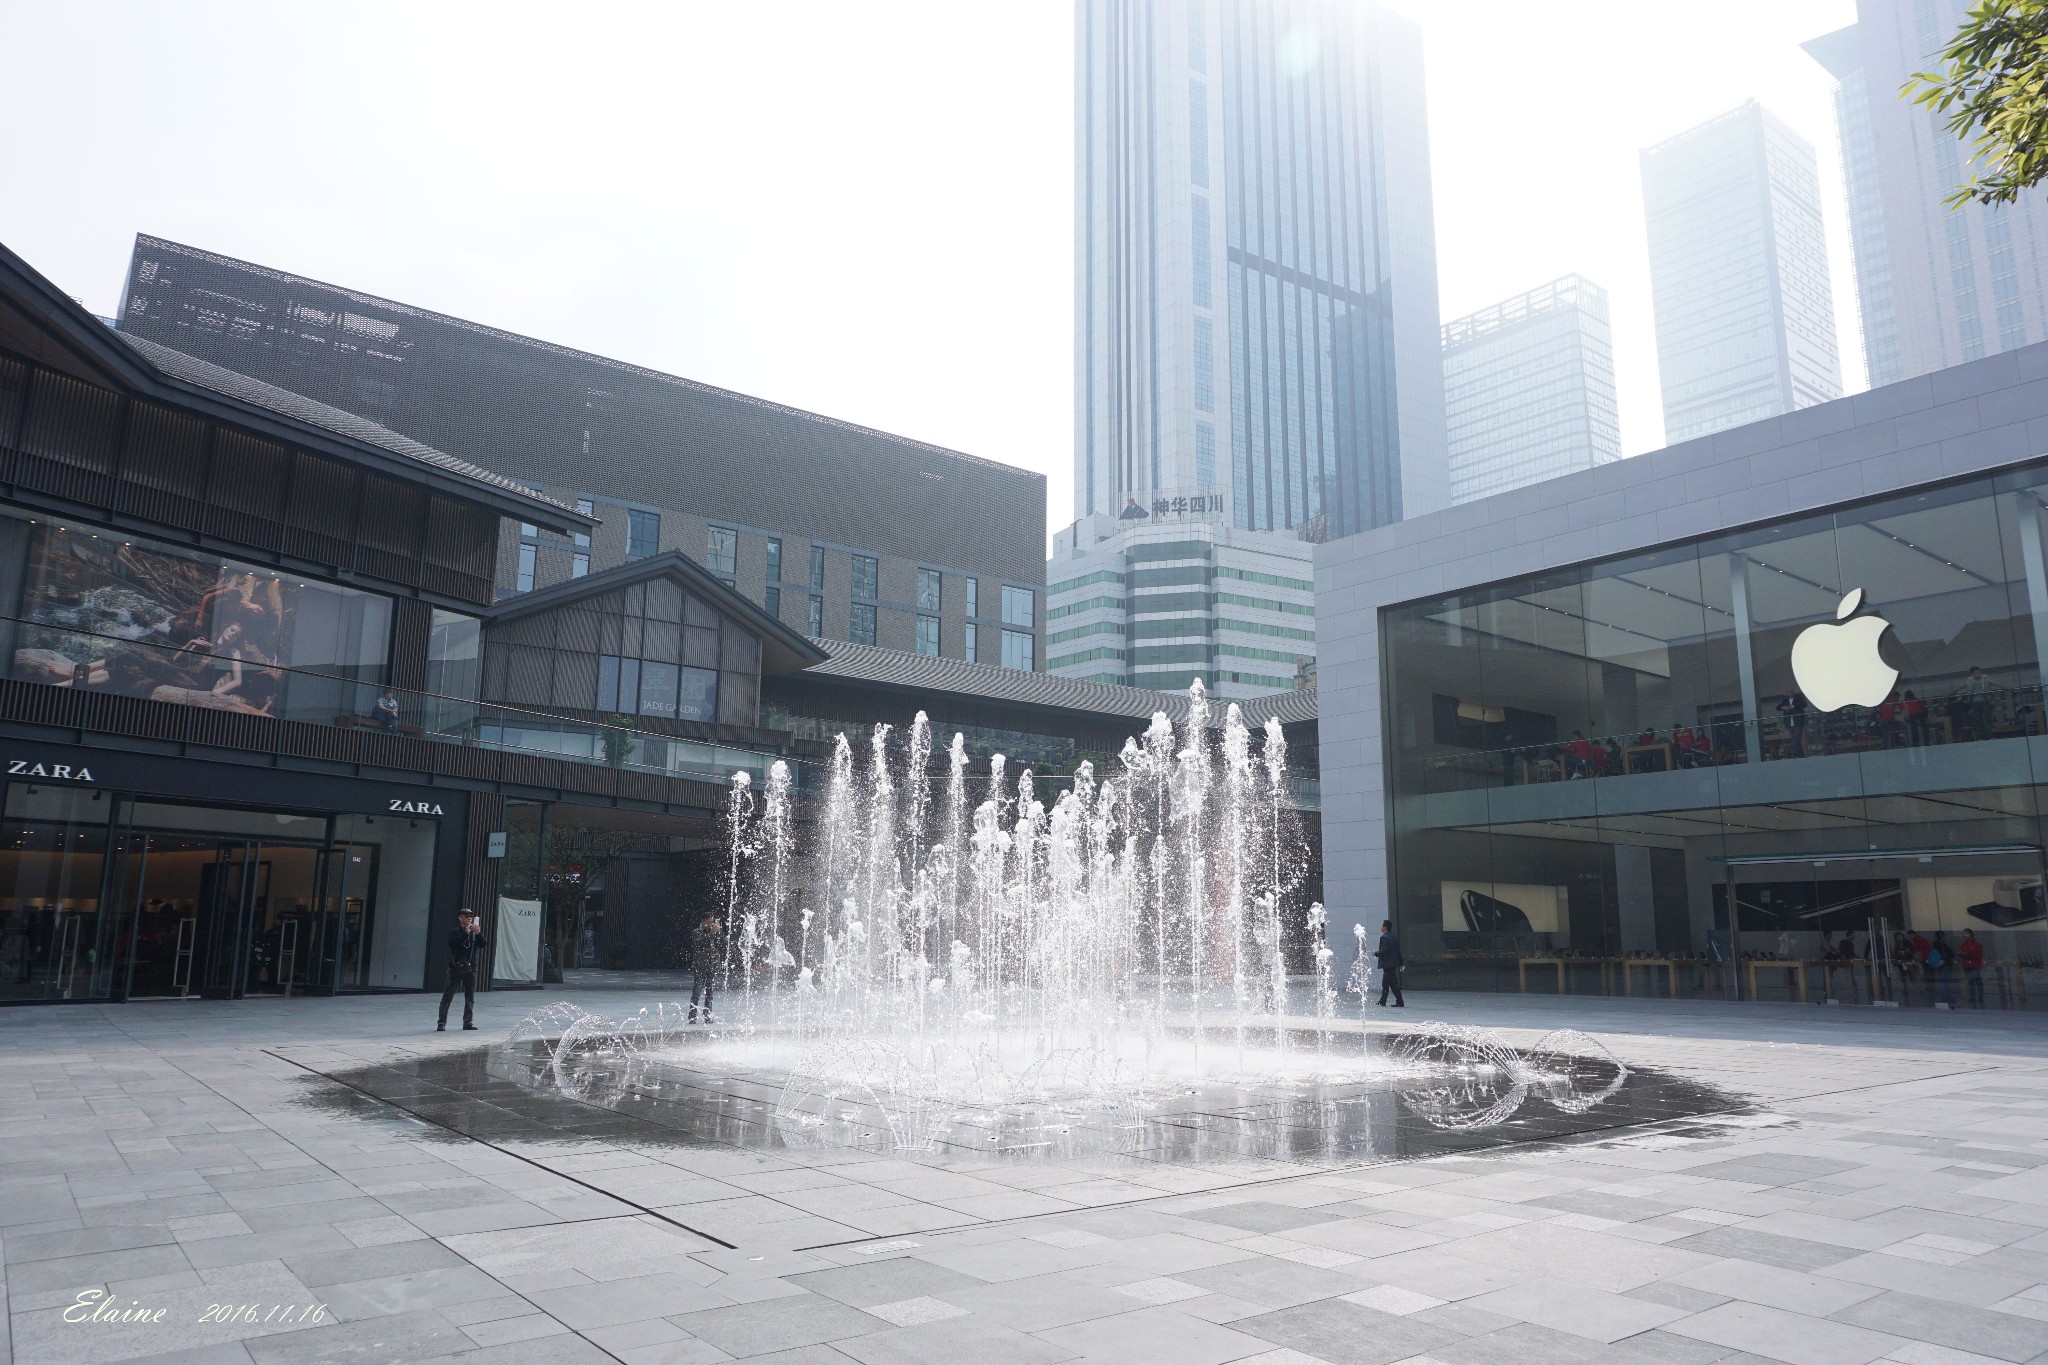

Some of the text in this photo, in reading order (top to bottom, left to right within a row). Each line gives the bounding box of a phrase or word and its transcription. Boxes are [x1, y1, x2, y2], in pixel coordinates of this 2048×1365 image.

[1152, 495, 1223, 517] 神华四川
[643, 700, 664, 711] JADE
[7, 760, 94, 781] ZARA
[388, 799, 444, 815] ZARA
[518, 909, 536, 917] ZARA
